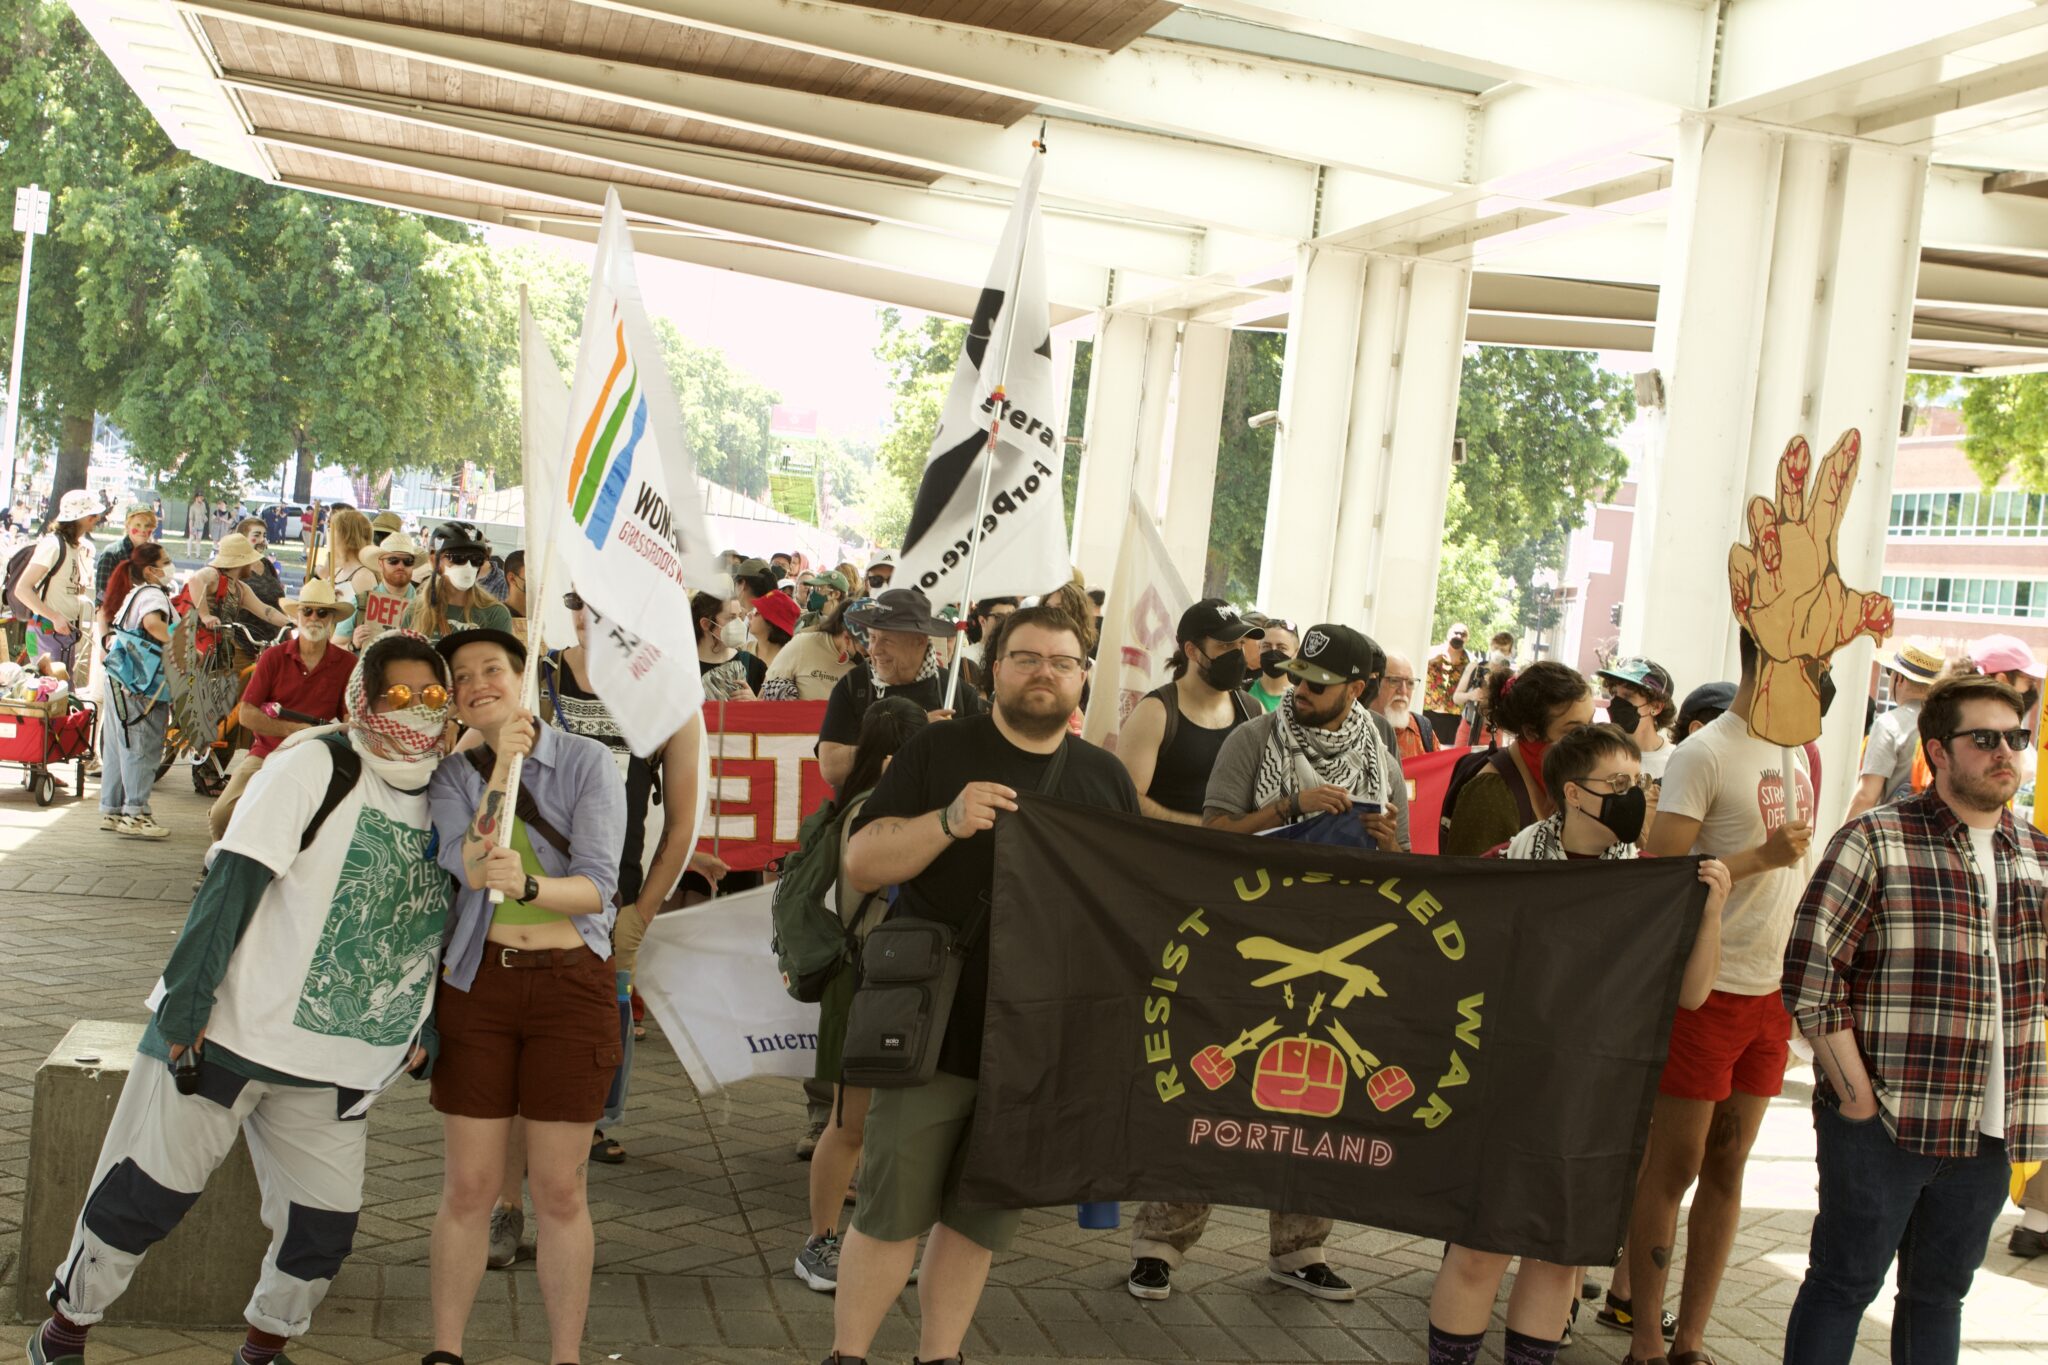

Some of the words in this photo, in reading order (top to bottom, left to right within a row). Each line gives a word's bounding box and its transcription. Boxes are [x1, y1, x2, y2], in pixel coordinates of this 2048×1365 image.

[1144, 907, 1210, 1103] RESIST
[1413, 992, 1485, 1129] WAR
[1190, 1118, 1393, 1167] PORTLAND
